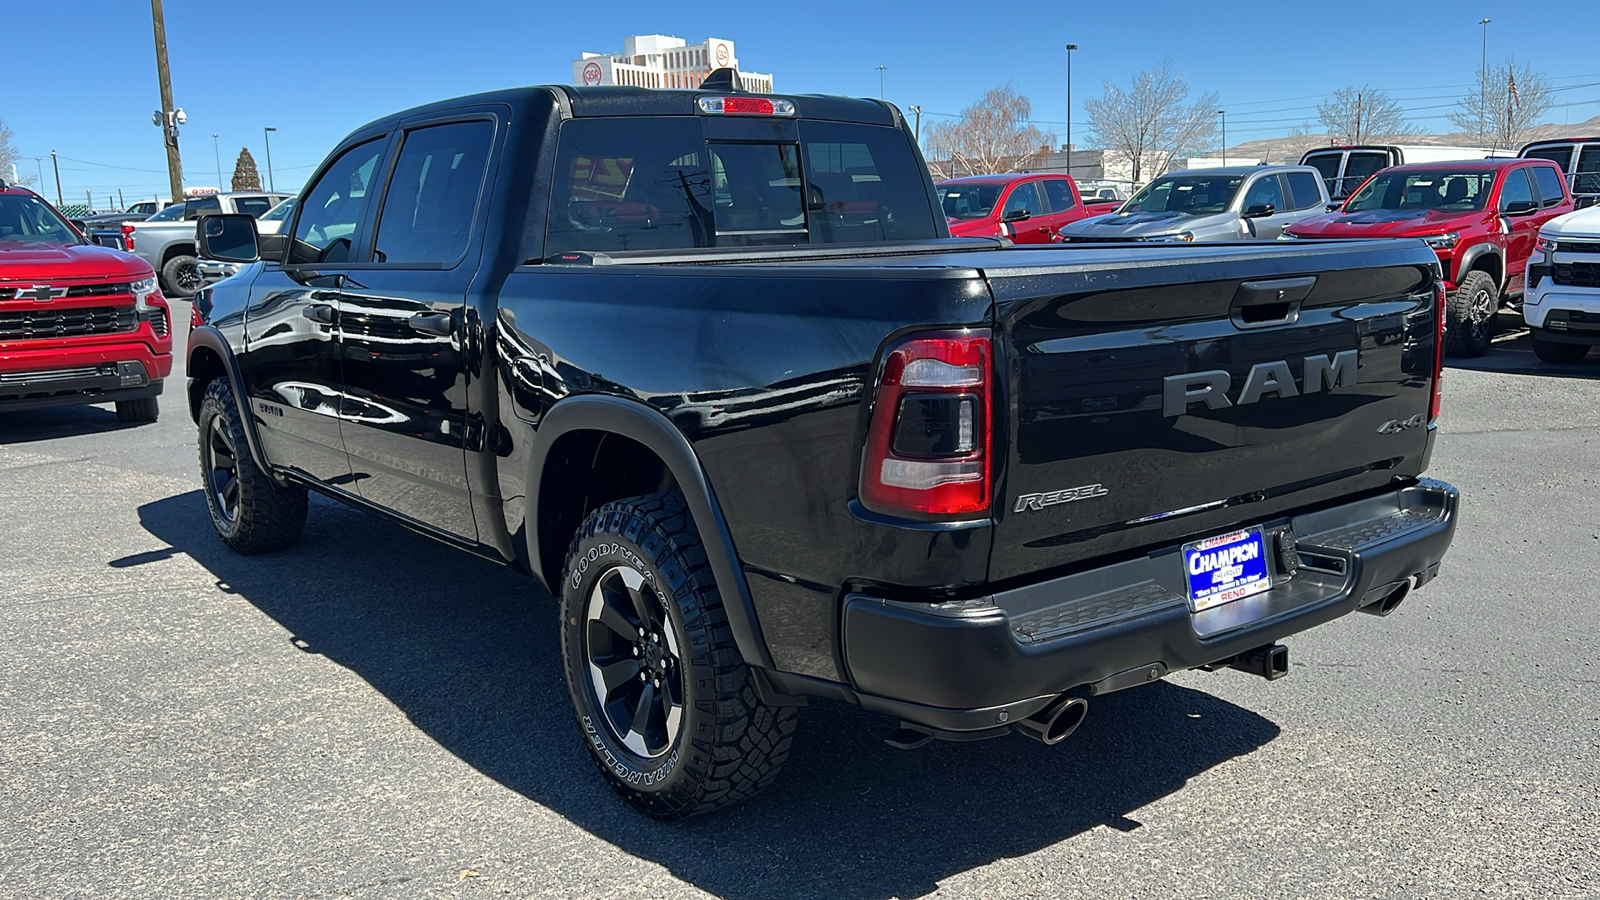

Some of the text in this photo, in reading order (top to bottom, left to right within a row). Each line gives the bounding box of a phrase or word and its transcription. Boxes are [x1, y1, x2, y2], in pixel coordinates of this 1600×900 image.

[585, 69, 600, 80] GSR
[1163, 349, 1358, 418] RAM
[1376, 413, 1425, 435] 4x4
[1013, 483, 1109, 513] REBEL
[1204, 531, 1243, 548] CHAMPION
[1189, 541, 1258, 575] CHAMPION
[571, 543, 670, 611] GOODYEAR
[1214, 567, 1241, 580] CHEVROLET
[1221, 587, 1246, 601] RENO
[583, 715, 680, 787] WRANGLER
